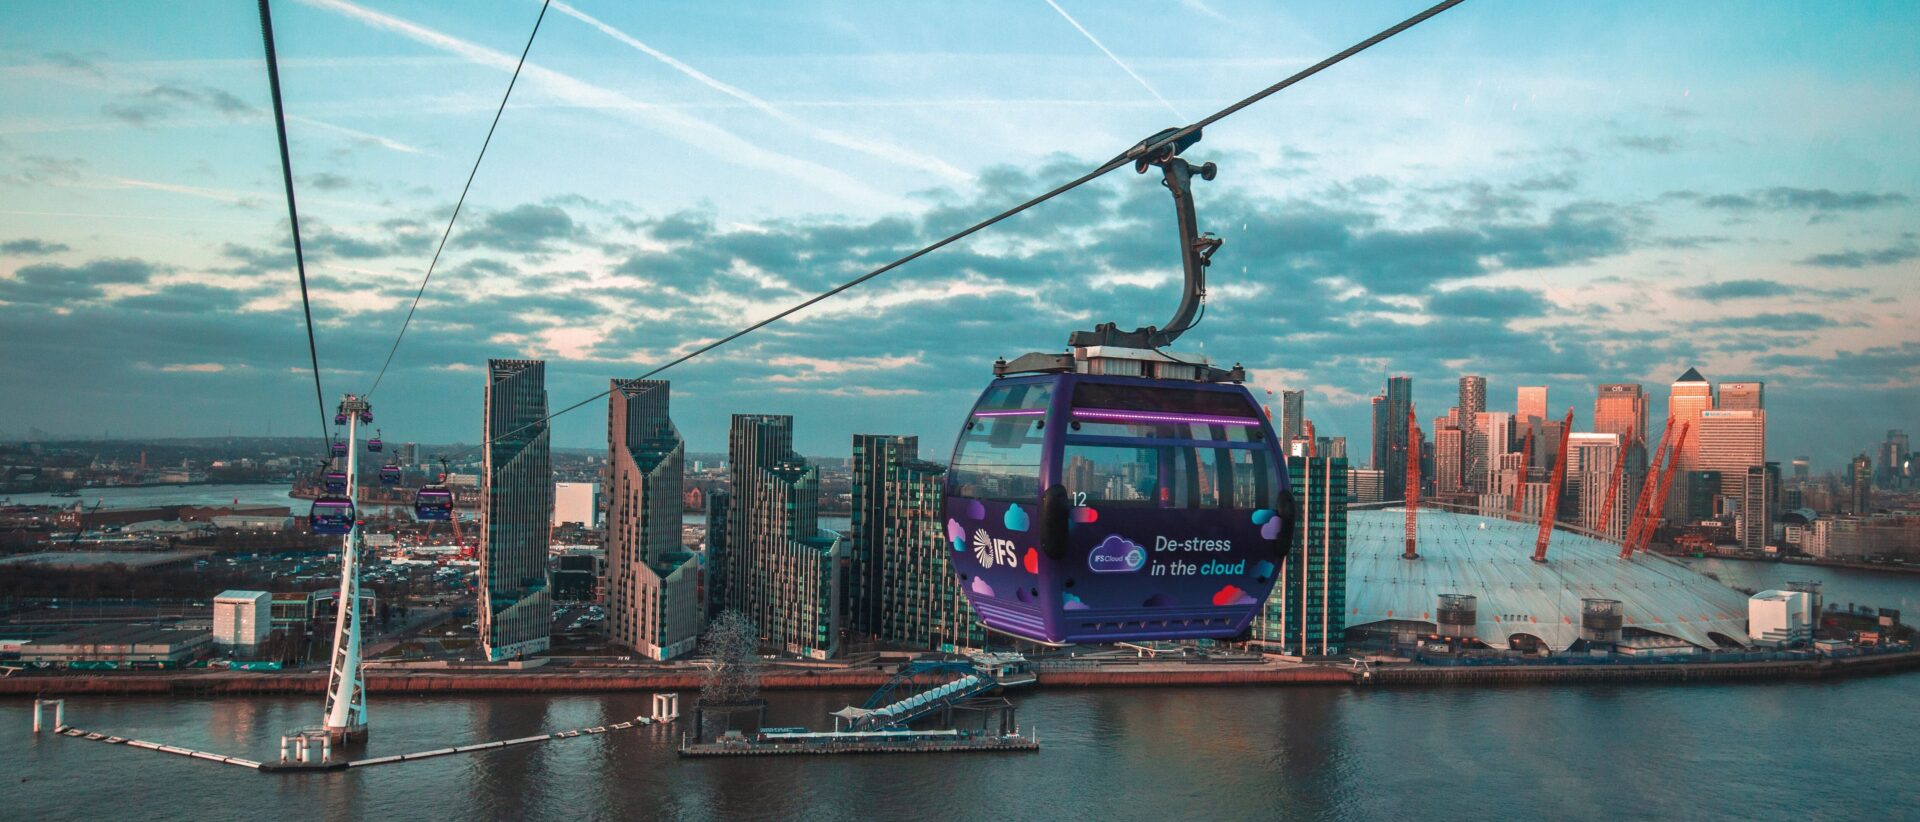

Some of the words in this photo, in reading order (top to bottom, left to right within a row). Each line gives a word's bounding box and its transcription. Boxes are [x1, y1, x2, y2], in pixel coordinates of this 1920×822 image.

[1072, 491, 1087, 507] 12
[1155, 535, 1231, 552] De-stress
[993, 538, 1018, 568] IFS
[1151, 559, 1167, 576] in
[1170, 559, 1197, 576] the
[1200, 559, 1245, 576] cloud
